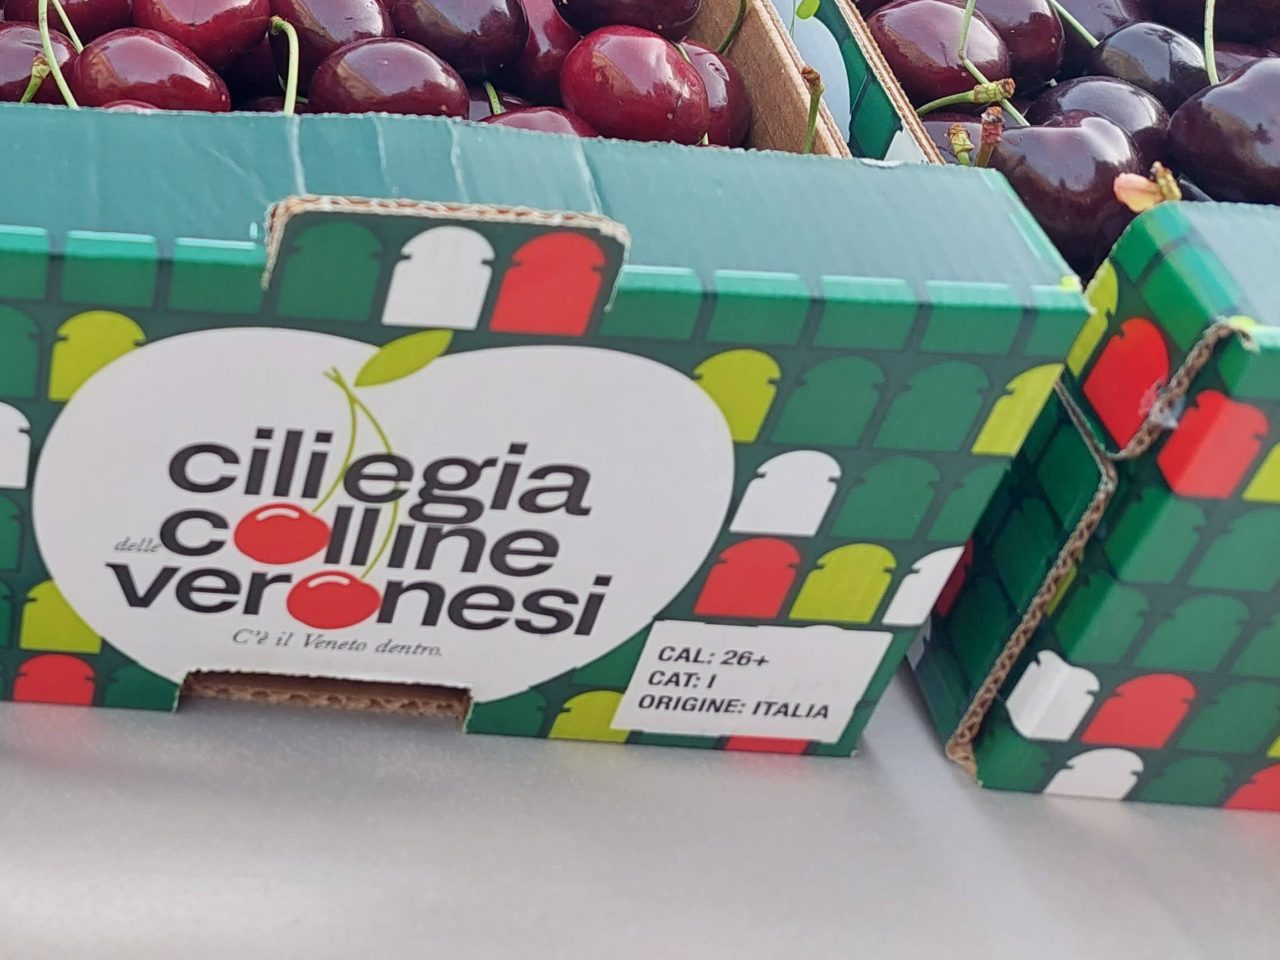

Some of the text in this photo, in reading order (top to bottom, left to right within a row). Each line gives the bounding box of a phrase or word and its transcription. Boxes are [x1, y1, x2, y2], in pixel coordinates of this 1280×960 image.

[168, 427, 592, 524] ciliegia
[114, 537, 160, 554] delle
[276, 632, 293, 647] il
[304, 632, 368, 652] Veneto
[375, 639, 443, 657] dentro.
[658, 645, 769, 667] CAL: 26+
[648, 670, 701, 688] CAT:
[638, 694, 829, 719] ORIGINE: ITALIA
